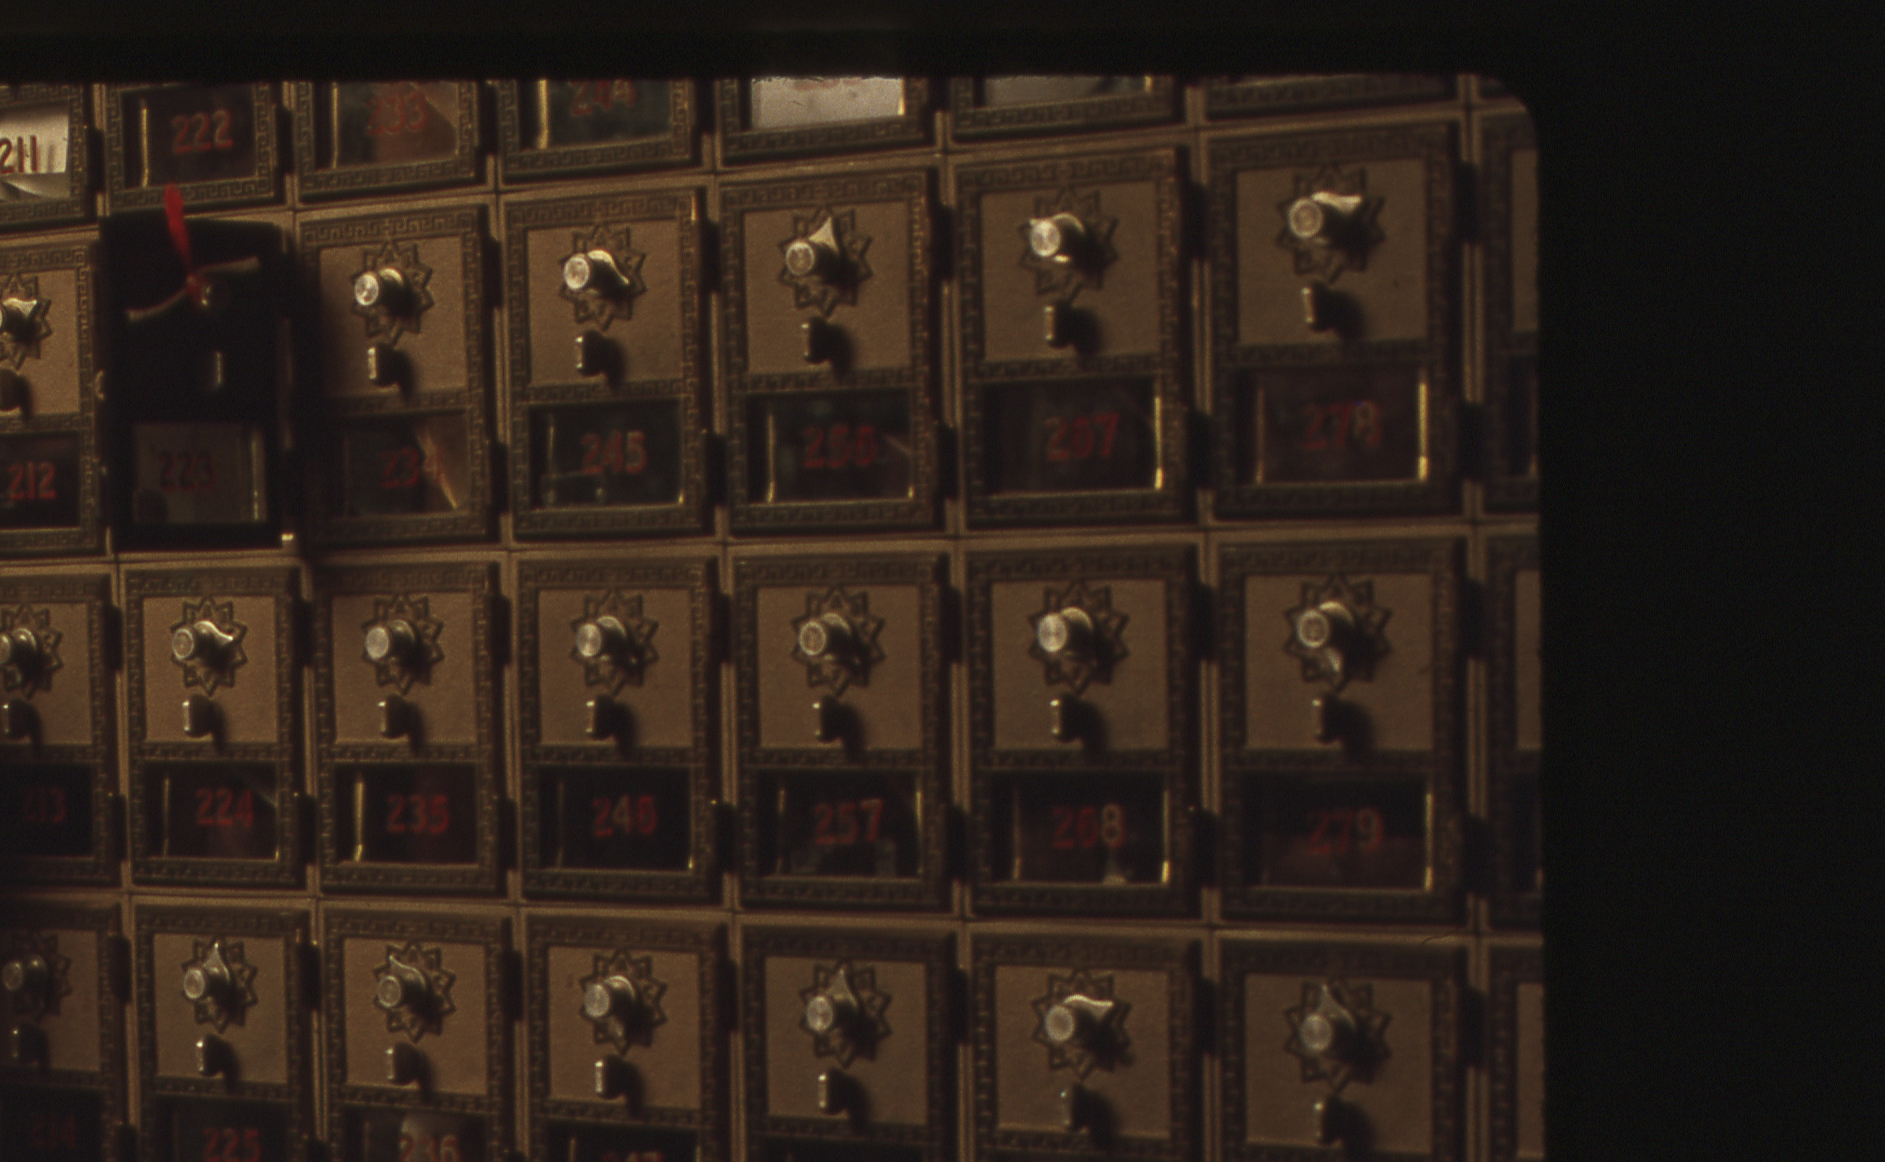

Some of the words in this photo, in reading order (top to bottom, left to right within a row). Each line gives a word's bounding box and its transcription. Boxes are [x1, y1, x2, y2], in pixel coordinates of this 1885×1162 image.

[171, 109, 233, 154] 222
[365, 91, 427, 137] 233
[1301, 402, 1382, 450] 278
[159, 451, 215, 491] 223
[581, 430, 647, 474] 245
[8, 463, 56, 501] 212
[196, 787, 253, 828] 224
[386, 794, 450, 835] 235
[592, 795, 657, 838] 246
[813, 799, 883, 845] 257
[1052, 803, 1127, 851] 268
